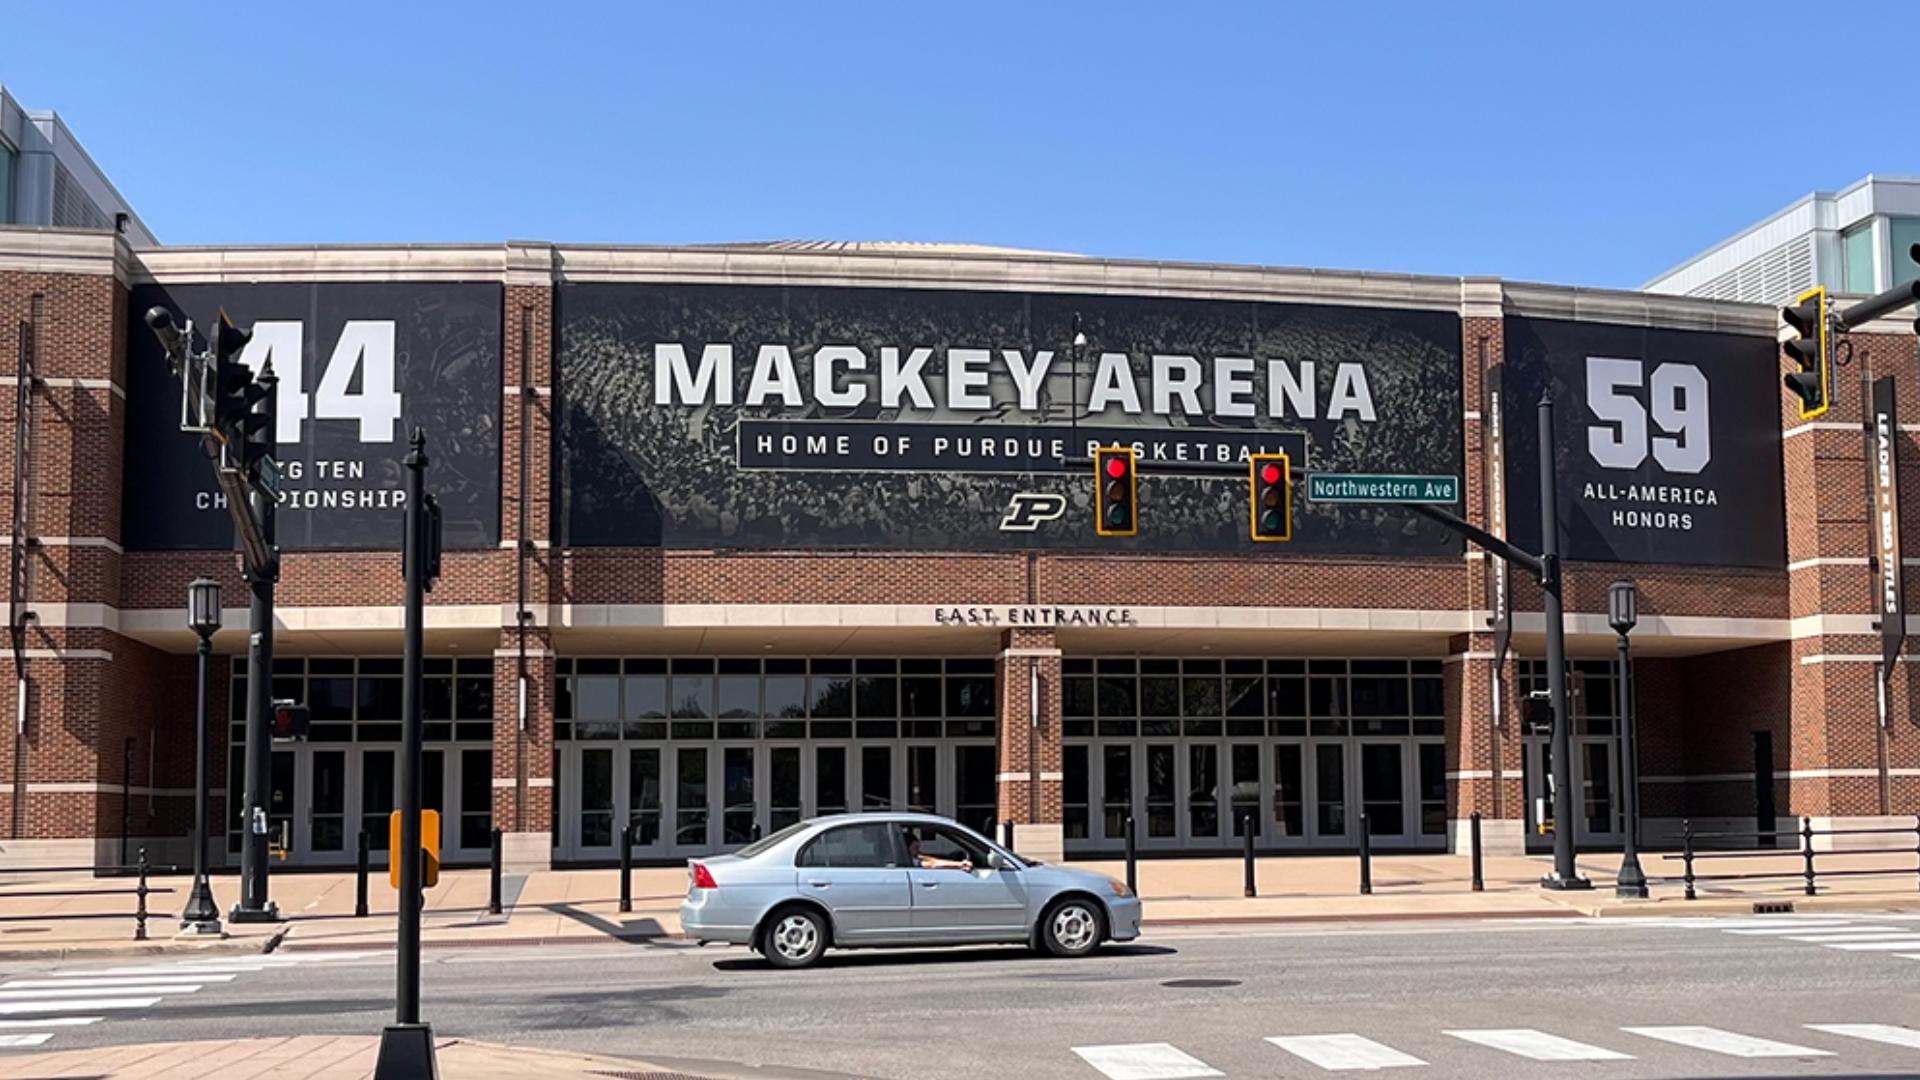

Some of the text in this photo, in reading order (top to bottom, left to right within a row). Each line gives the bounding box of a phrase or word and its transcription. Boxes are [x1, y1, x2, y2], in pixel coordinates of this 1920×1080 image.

[232, 320, 402, 443] 44
[655, 343, 1377, 422] MACKEY ARENA
[1586, 356, 1711, 474] 59
[757, 436, 1287, 463] HOME OF PURDUE BSKETBA
[316, 461, 365, 480] TEN
[1315, 480, 1452, 498] Northwestern Ave
[1584, 483, 1718, 506] ALL-AMERICA
[999, 494, 1067, 530] P
[1613, 510, 1693, 530] HONORS
[1877, 413, 1890, 488] LEADER
[1884, 552, 1897, 613] TITLES
[935, 608, 1131, 624] EAST ENTRANCE
